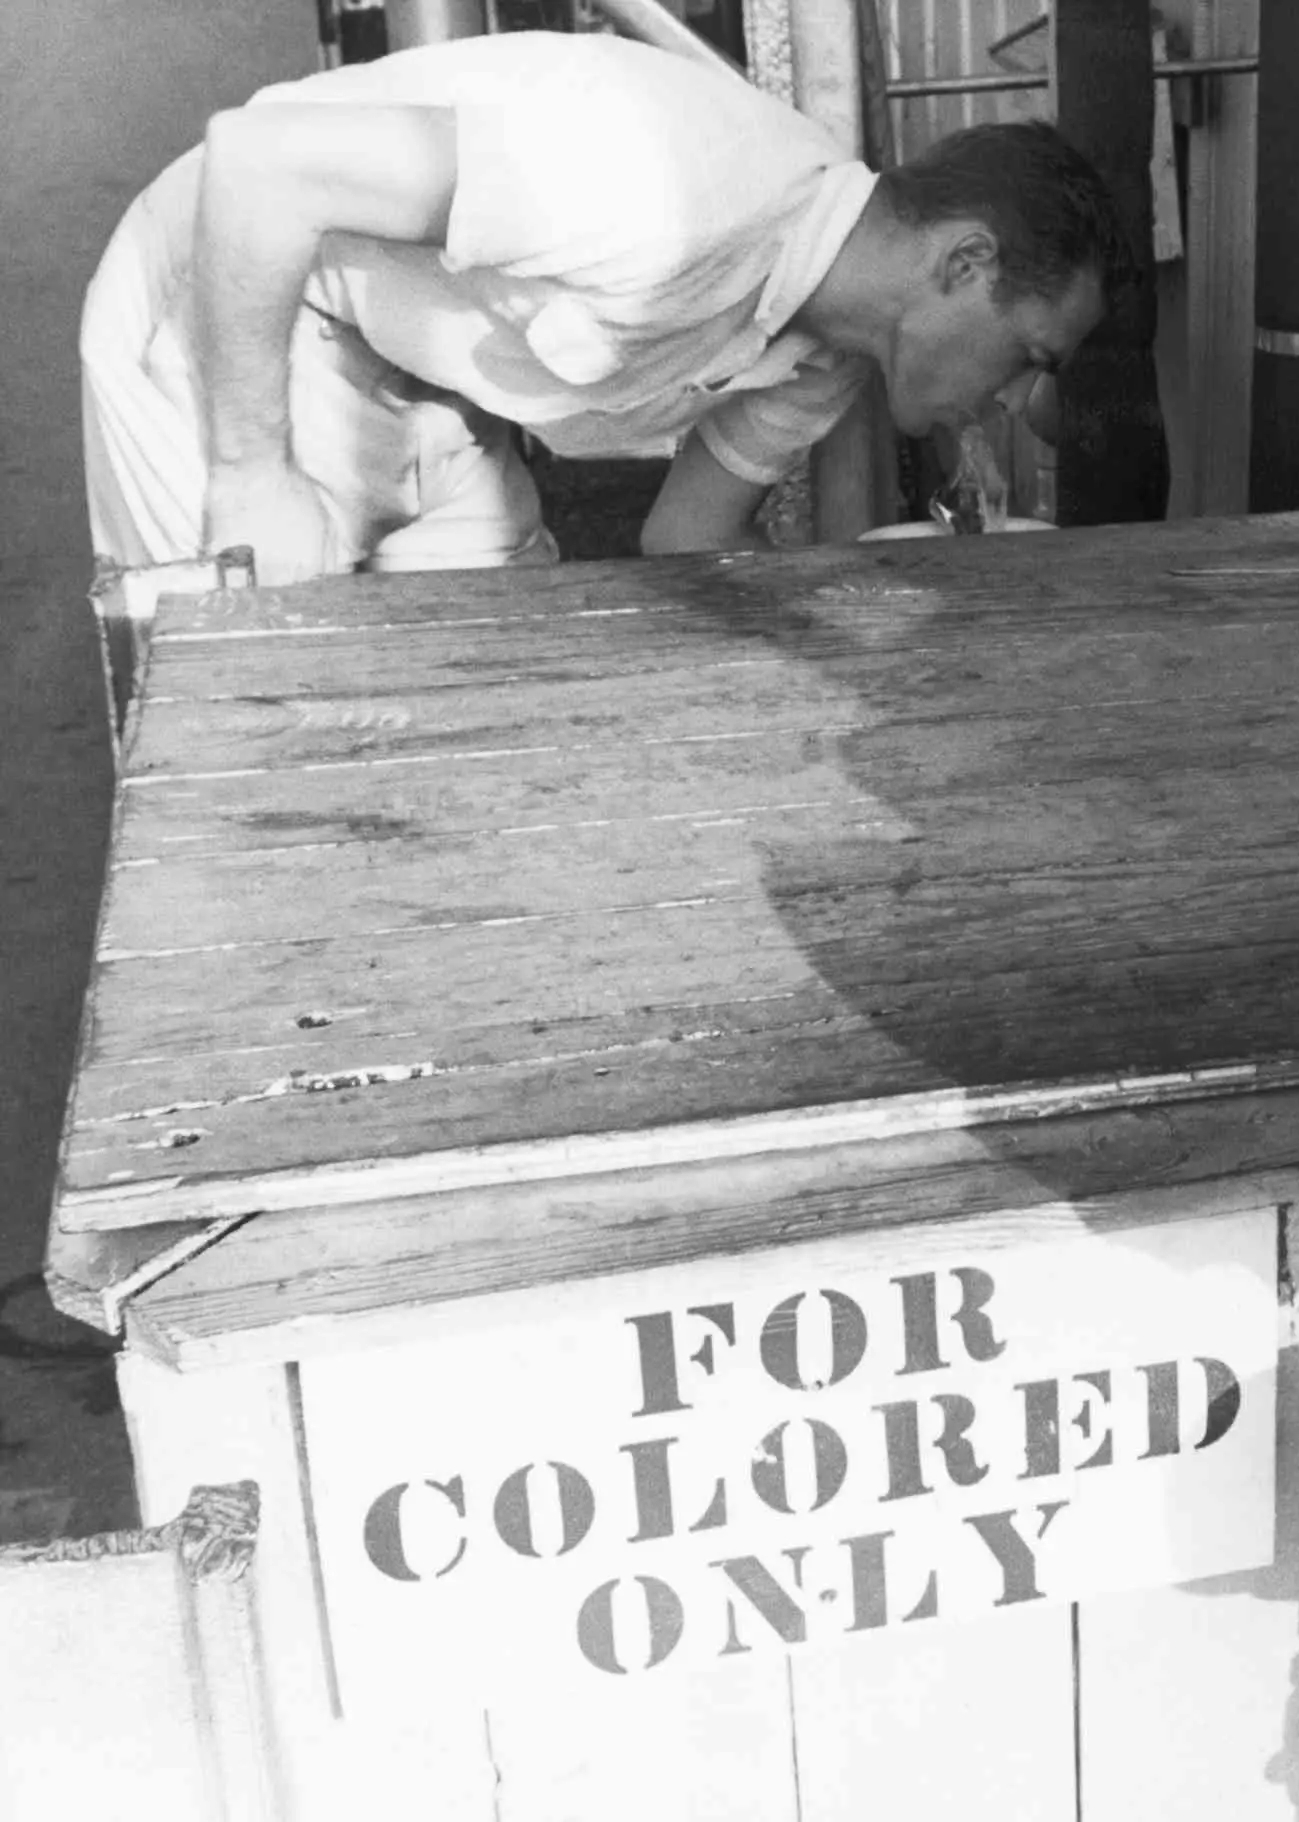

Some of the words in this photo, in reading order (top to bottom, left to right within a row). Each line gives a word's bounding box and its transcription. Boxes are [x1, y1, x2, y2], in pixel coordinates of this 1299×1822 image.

[625, 1266, 1007, 1417] FOR
[363, 1356, 1242, 1582] COLORED
[576, 1500, 1071, 1675] ONLY
